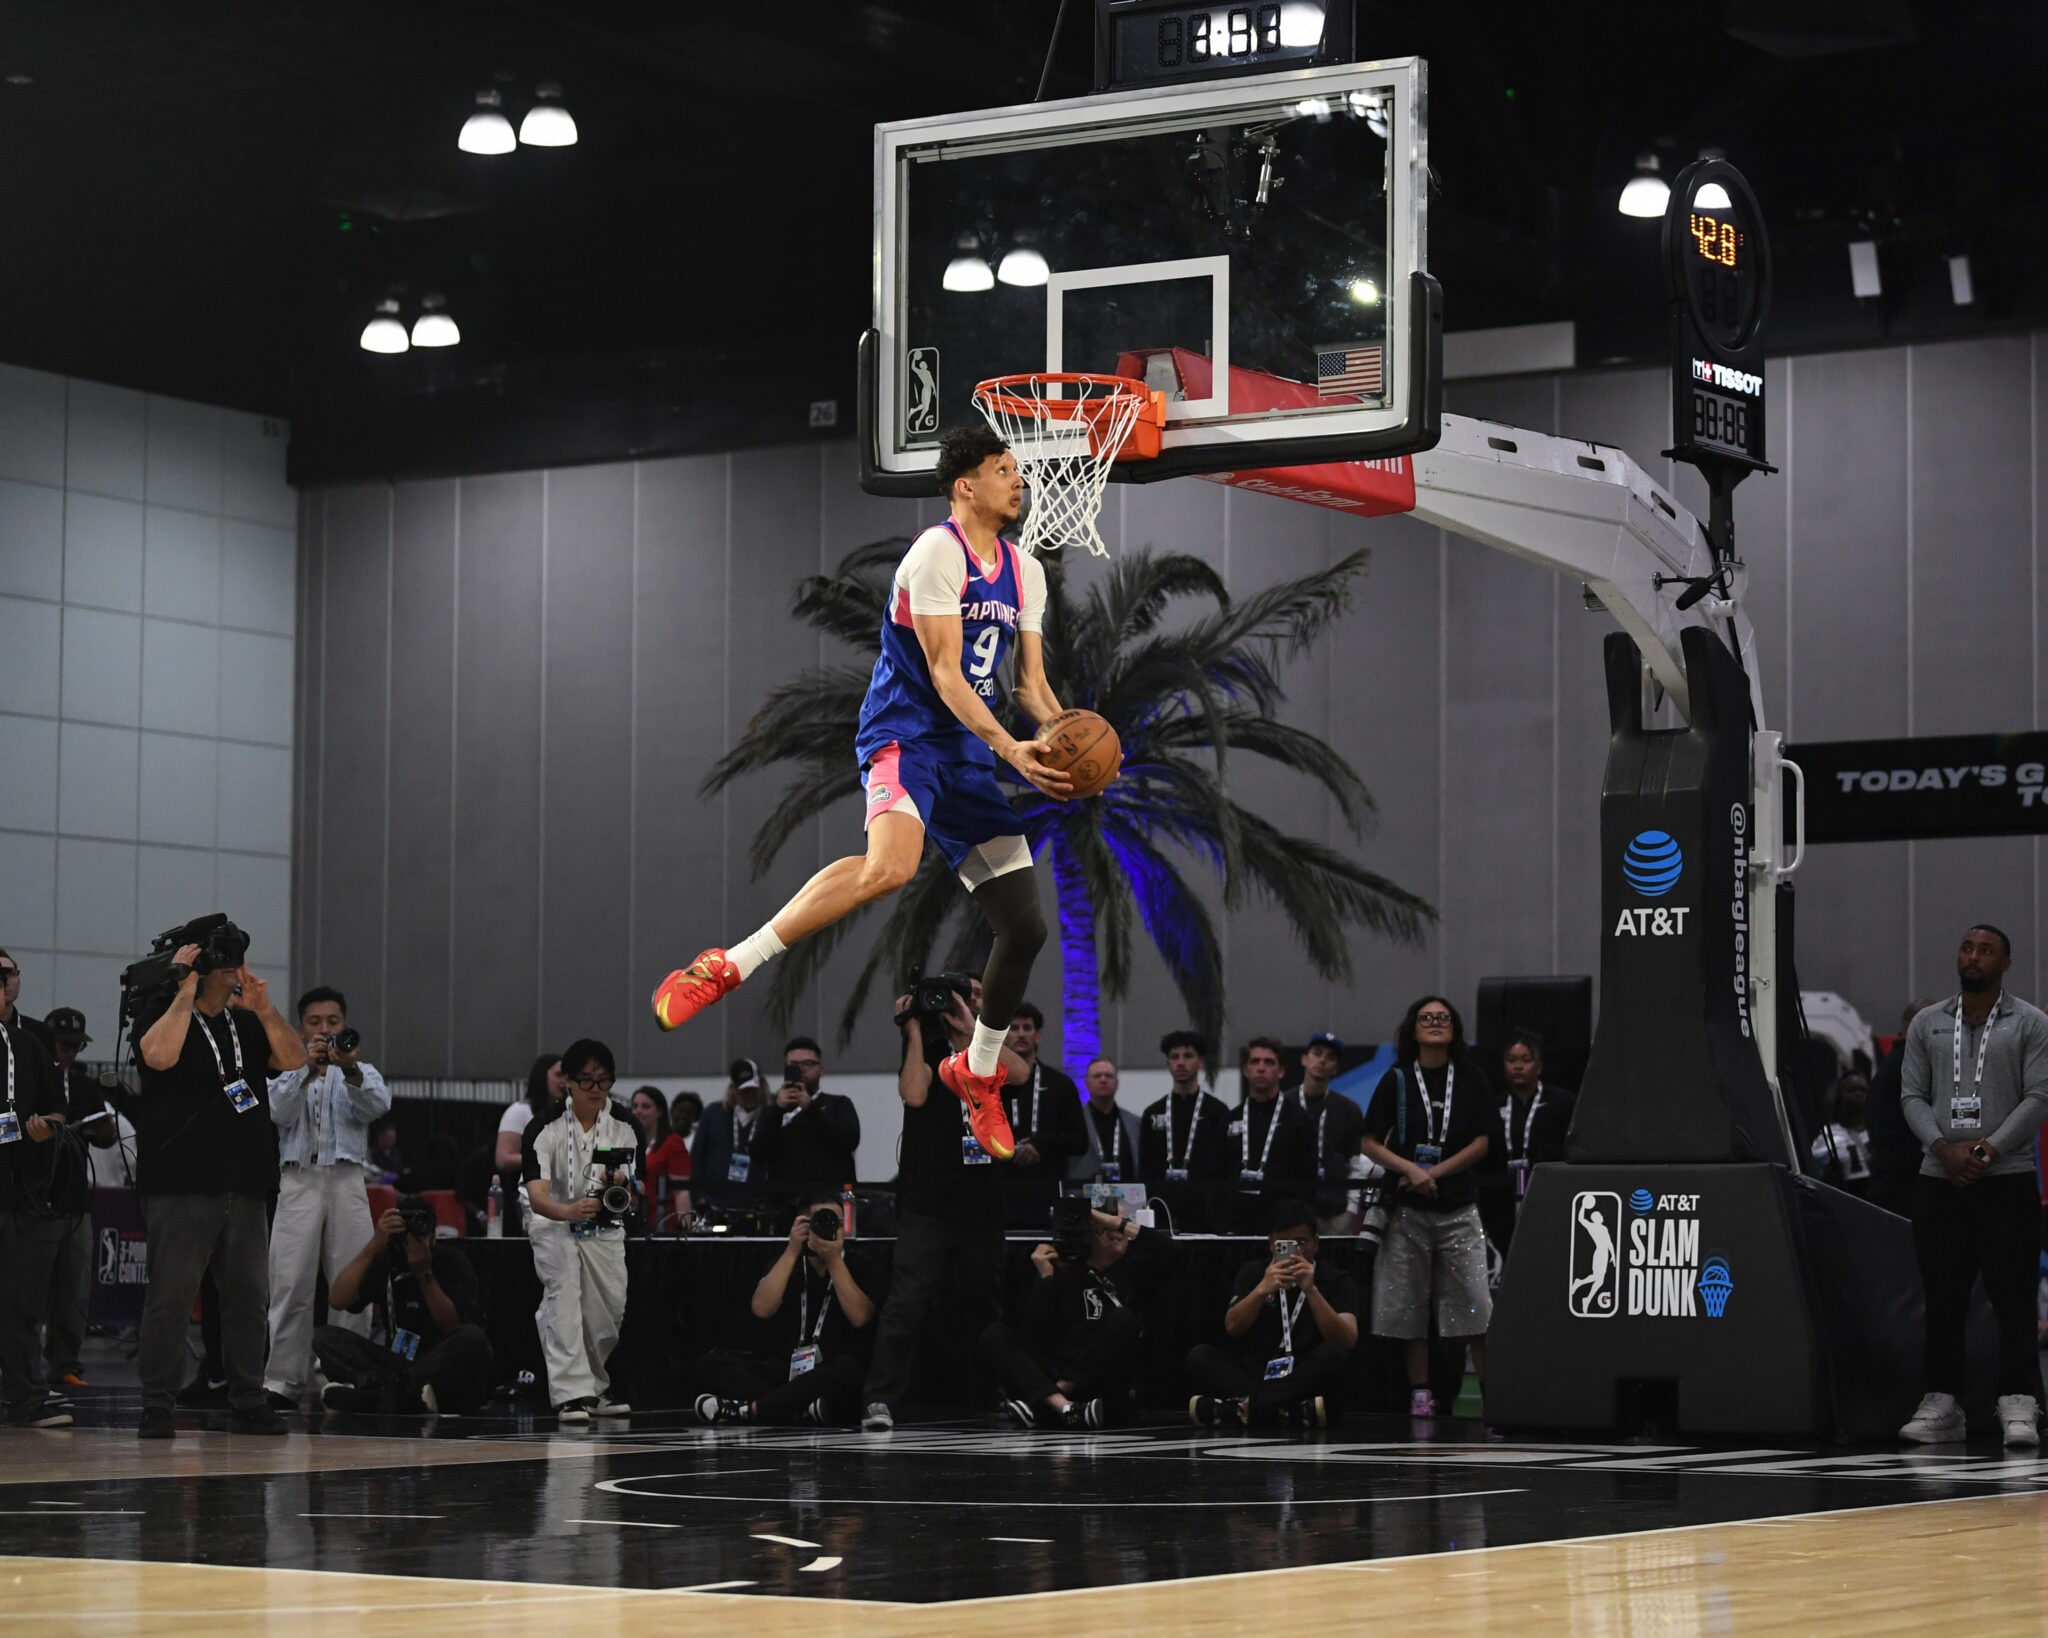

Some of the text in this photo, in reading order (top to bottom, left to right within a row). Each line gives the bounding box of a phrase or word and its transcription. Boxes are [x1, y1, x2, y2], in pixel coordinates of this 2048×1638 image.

[1689, 213, 1736, 266] 42.8
[1712, 363, 1763, 397] TISSOT
[969, 625, 1001, 678] 9
[1836, 764, 2008, 793] TODAY'S
[2017, 785, 2048, 808] T
[1614, 907, 1690, 937] AT&T
[1730, 801, 1751, 1038] @nbagleague
[1657, 1194, 1700, 1211] AT&T
[1629, 1218, 1700, 1267] SLAM
[1628, 1268, 1698, 1317] DUNK
